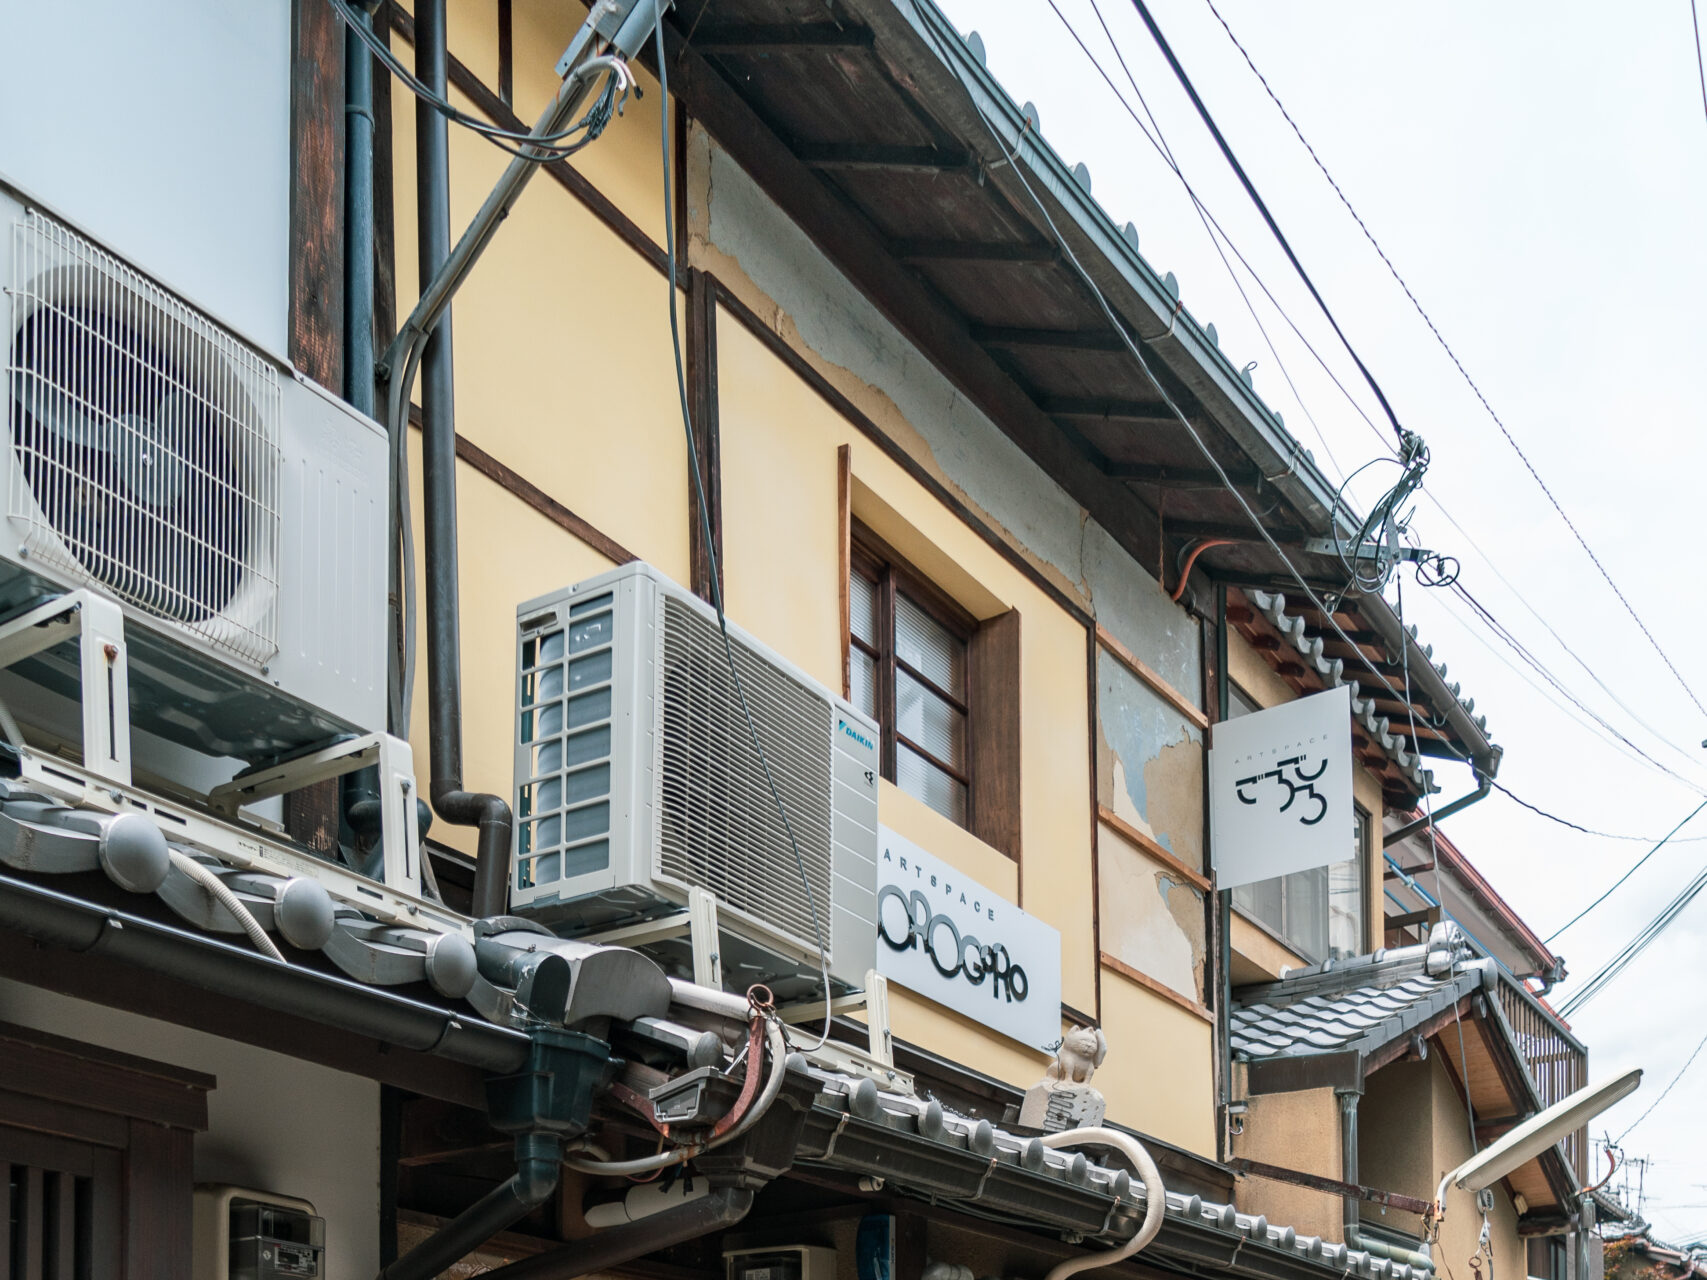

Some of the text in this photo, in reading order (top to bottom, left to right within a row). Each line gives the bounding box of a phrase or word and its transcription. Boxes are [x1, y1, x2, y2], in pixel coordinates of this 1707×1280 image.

[845, 726, 874, 751] DAIKIN
[1233, 734, 1330, 765] ARTSPACE
[883, 848, 995, 922] ARTSPACE
[877, 884, 1029, 1004] OROGORO
